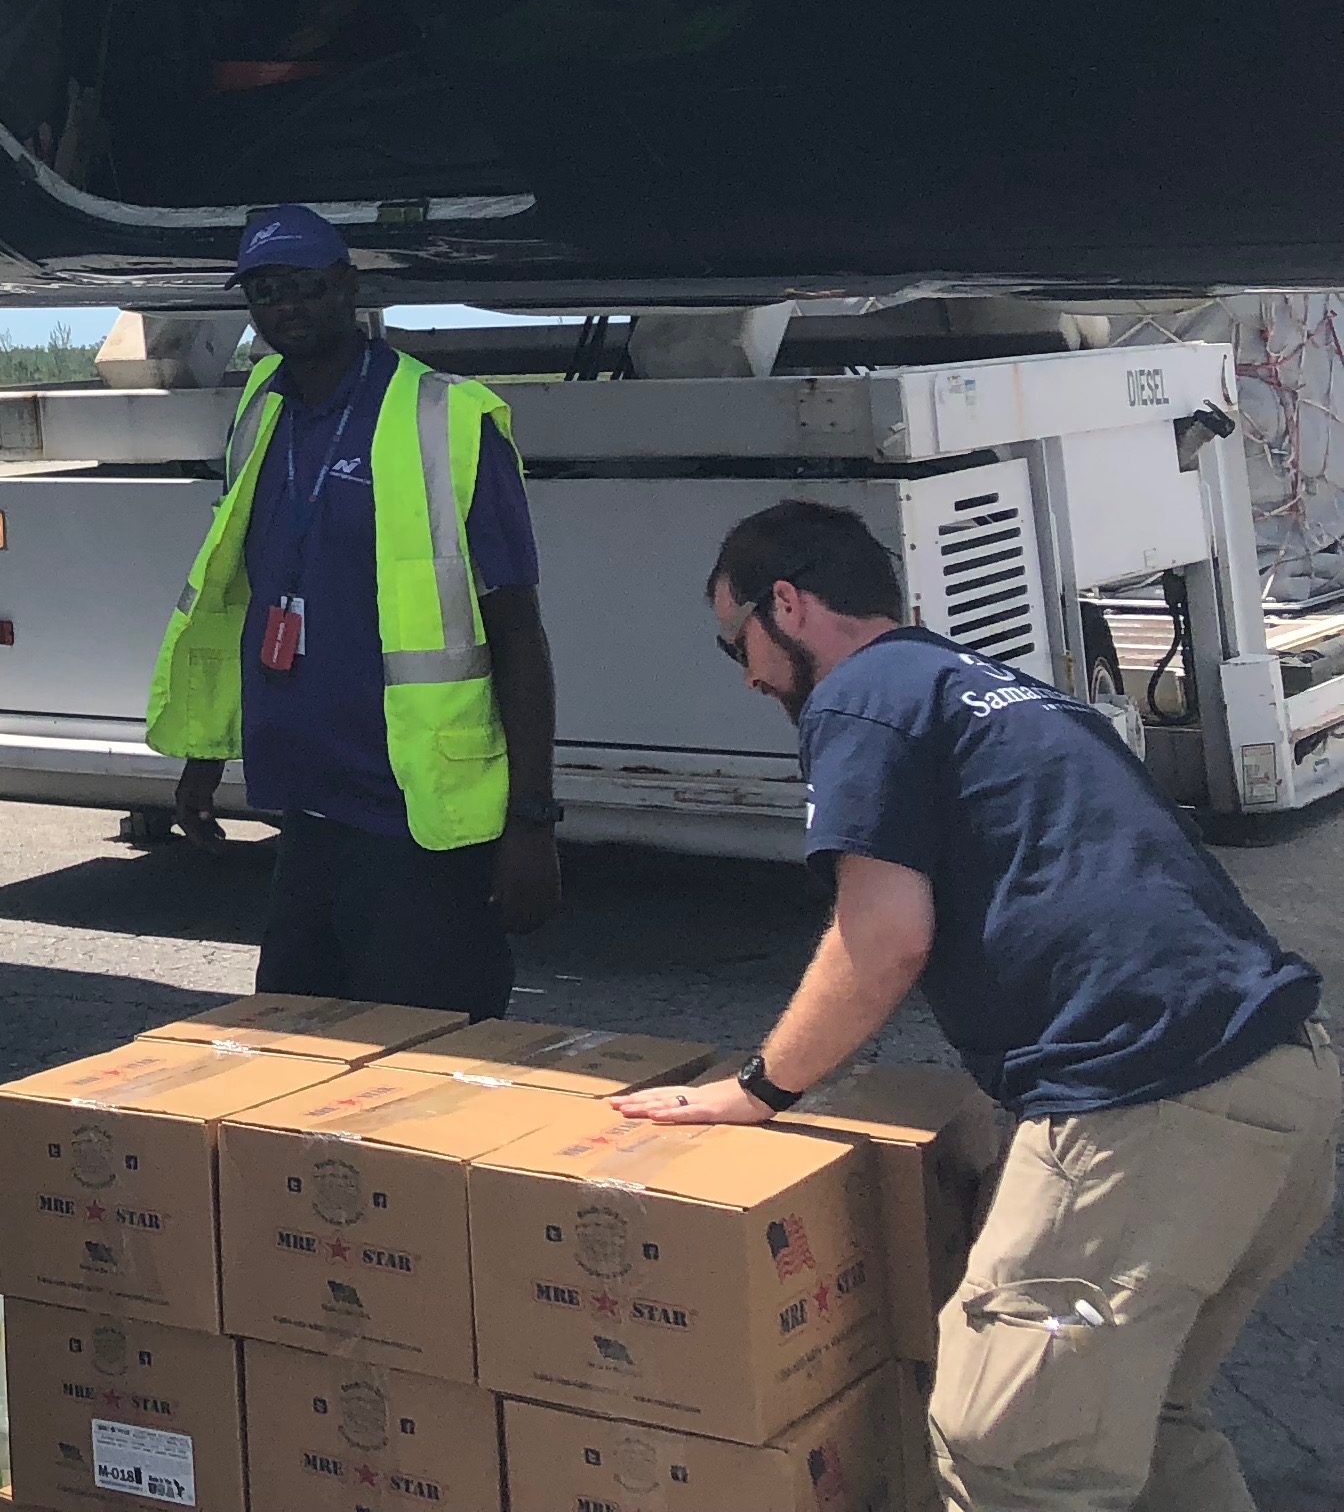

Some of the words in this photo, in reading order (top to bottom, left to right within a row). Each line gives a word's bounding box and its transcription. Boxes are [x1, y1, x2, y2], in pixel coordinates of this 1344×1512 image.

[1126, 369, 1169, 406] DIESEL
[39, 1194, 75, 1216] MRE
[116, 1208, 161, 1230] STAR
[277, 1231, 316, 1253] MRE
[362, 1249, 413, 1273] STAR
[536, 1282, 580, 1307] MRE
[632, 1301, 688, 1328] STAR
[779, 1298, 808, 1335] MRE
[131, 1395, 172, 1416] STAR
[303, 1452, 344, 1477] MRE
[390, 1474, 440, 1501] STAR
